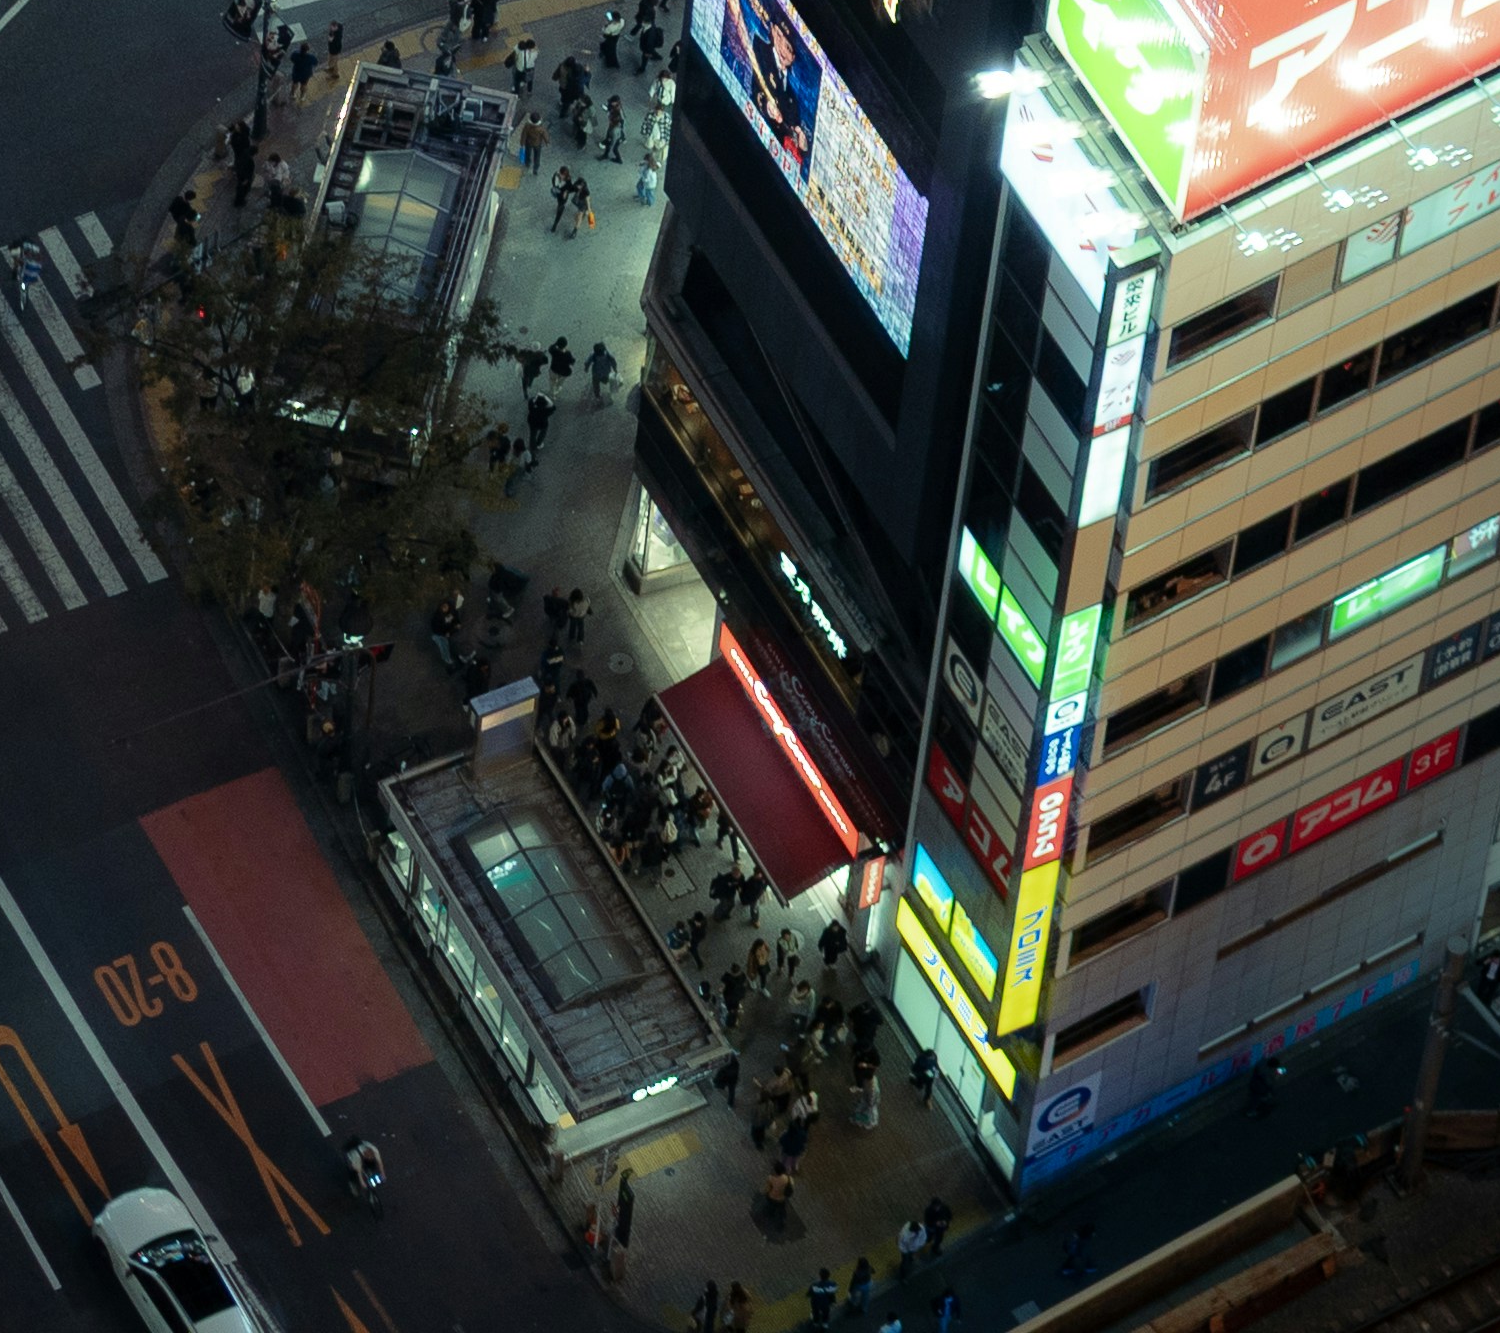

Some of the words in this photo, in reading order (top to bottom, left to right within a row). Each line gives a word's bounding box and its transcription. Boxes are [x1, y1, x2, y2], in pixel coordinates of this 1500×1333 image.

[975, 555, 1046, 664] レイク
[1320, 664, 1414, 723] EAST
[1204, 767, 1238, 795] 4F
[1413, 741, 1453, 777] 3F
[1299, 775, 1396, 839] アコム
[93, 939, 199, 1027] 8-20
[1012, 905, 1050, 989] プロミス
[922, 939, 990, 1053] プロミス
